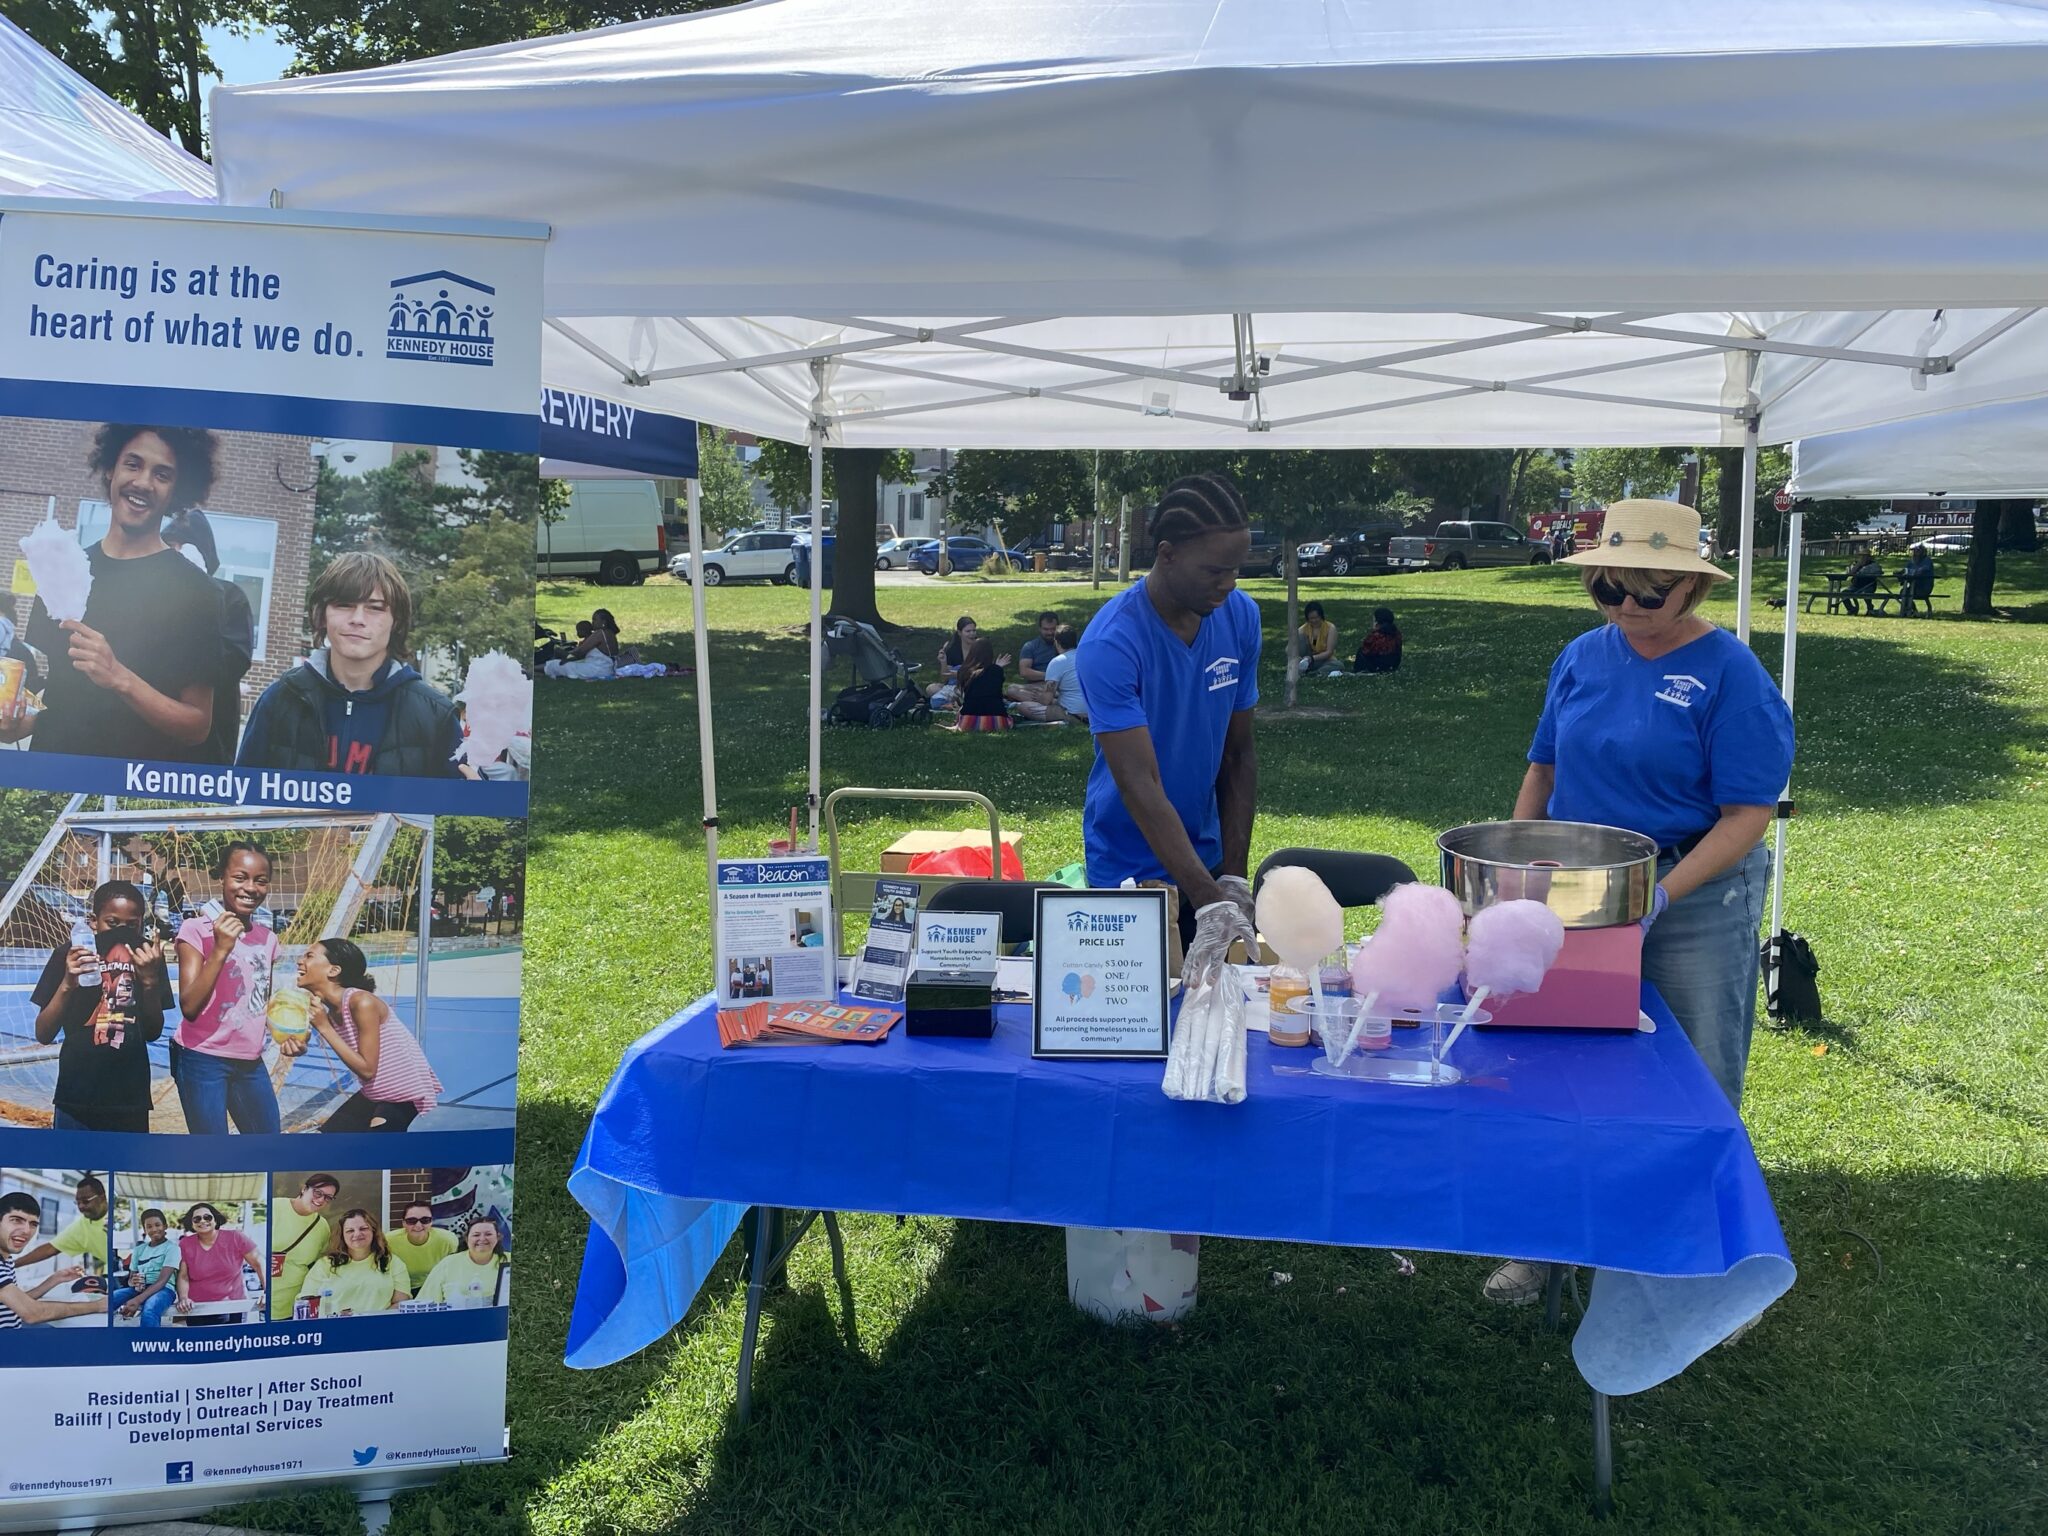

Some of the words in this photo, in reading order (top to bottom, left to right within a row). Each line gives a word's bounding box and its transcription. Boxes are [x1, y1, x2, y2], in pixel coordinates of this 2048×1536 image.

[34, 254, 138, 299] Caring
[150, 260, 177, 294] is
[188, 264, 219, 296] at
[230, 265, 280, 300] the
[29, 304, 113, 341] heart
[124, 310, 155, 343] of
[164, 313, 243, 349] what
[253, 324, 300, 353] we
[314, 322, 363, 357] do.
[387, 338, 446, 354] KENNEDY
[450, 342, 493, 358] HOUSE
[1917, 514, 1944, 525] Hair
[1946, 513, 1974, 525] Mod
[126, 762, 250, 805] Kennedy
[261, 771, 352, 805] House
[757, 864, 809, 883] Beacon
[793, 890, 822, 898] Expansion
[1091, 914, 1137, 923] KENNEDY
[947, 927, 988, 936] KENNEDY
[1091, 923, 1124, 932] HOUSE
[1079, 938, 1105, 946] PRICE
[1106, 938, 1125, 946] LIST
[1105, 959, 1129, 968] $3.00
[1130, 959, 1143, 967] for
[1104, 972, 1125, 980] ONE
[1105, 984, 1129, 993] $5.00
[1130, 984, 1149, 992] FOR
[1105, 997, 1128, 1005] TWO
[1055, 1015, 1065, 1023] All
[1066, 1016, 1098, 1024] proceeds
[1127, 1016, 1148, 1024] youth
[1044, 1025, 1088, 1033] experiencing
[1080, 1035, 1123, 1043] community!
[131, 1332, 322, 1353] www.kennedyhouse.org
[88, 1389, 179, 1406] Residential
[195, 1385, 253, 1401] Shelter
[267, 1380, 305, 1395] After
[310, 1375, 362, 1391] School
[54, 1412, 102, 1427] Bailiff
[117, 1409, 181, 1425] Custody
[197, 1402, 268, 1420] Outreach
[283, 1398, 313, 1414] Day
[317, 1391, 394, 1409] Treatment
[129, 1422, 250, 1444] Developmental
[256, 1417, 323, 1433] Services
[386, 1445, 477, 1460] @KennedyHouseYou
[203, 1460, 303, 1477] @kennedyhouse1971
[9, 1477, 113, 1491] @kennedyhouse1971
